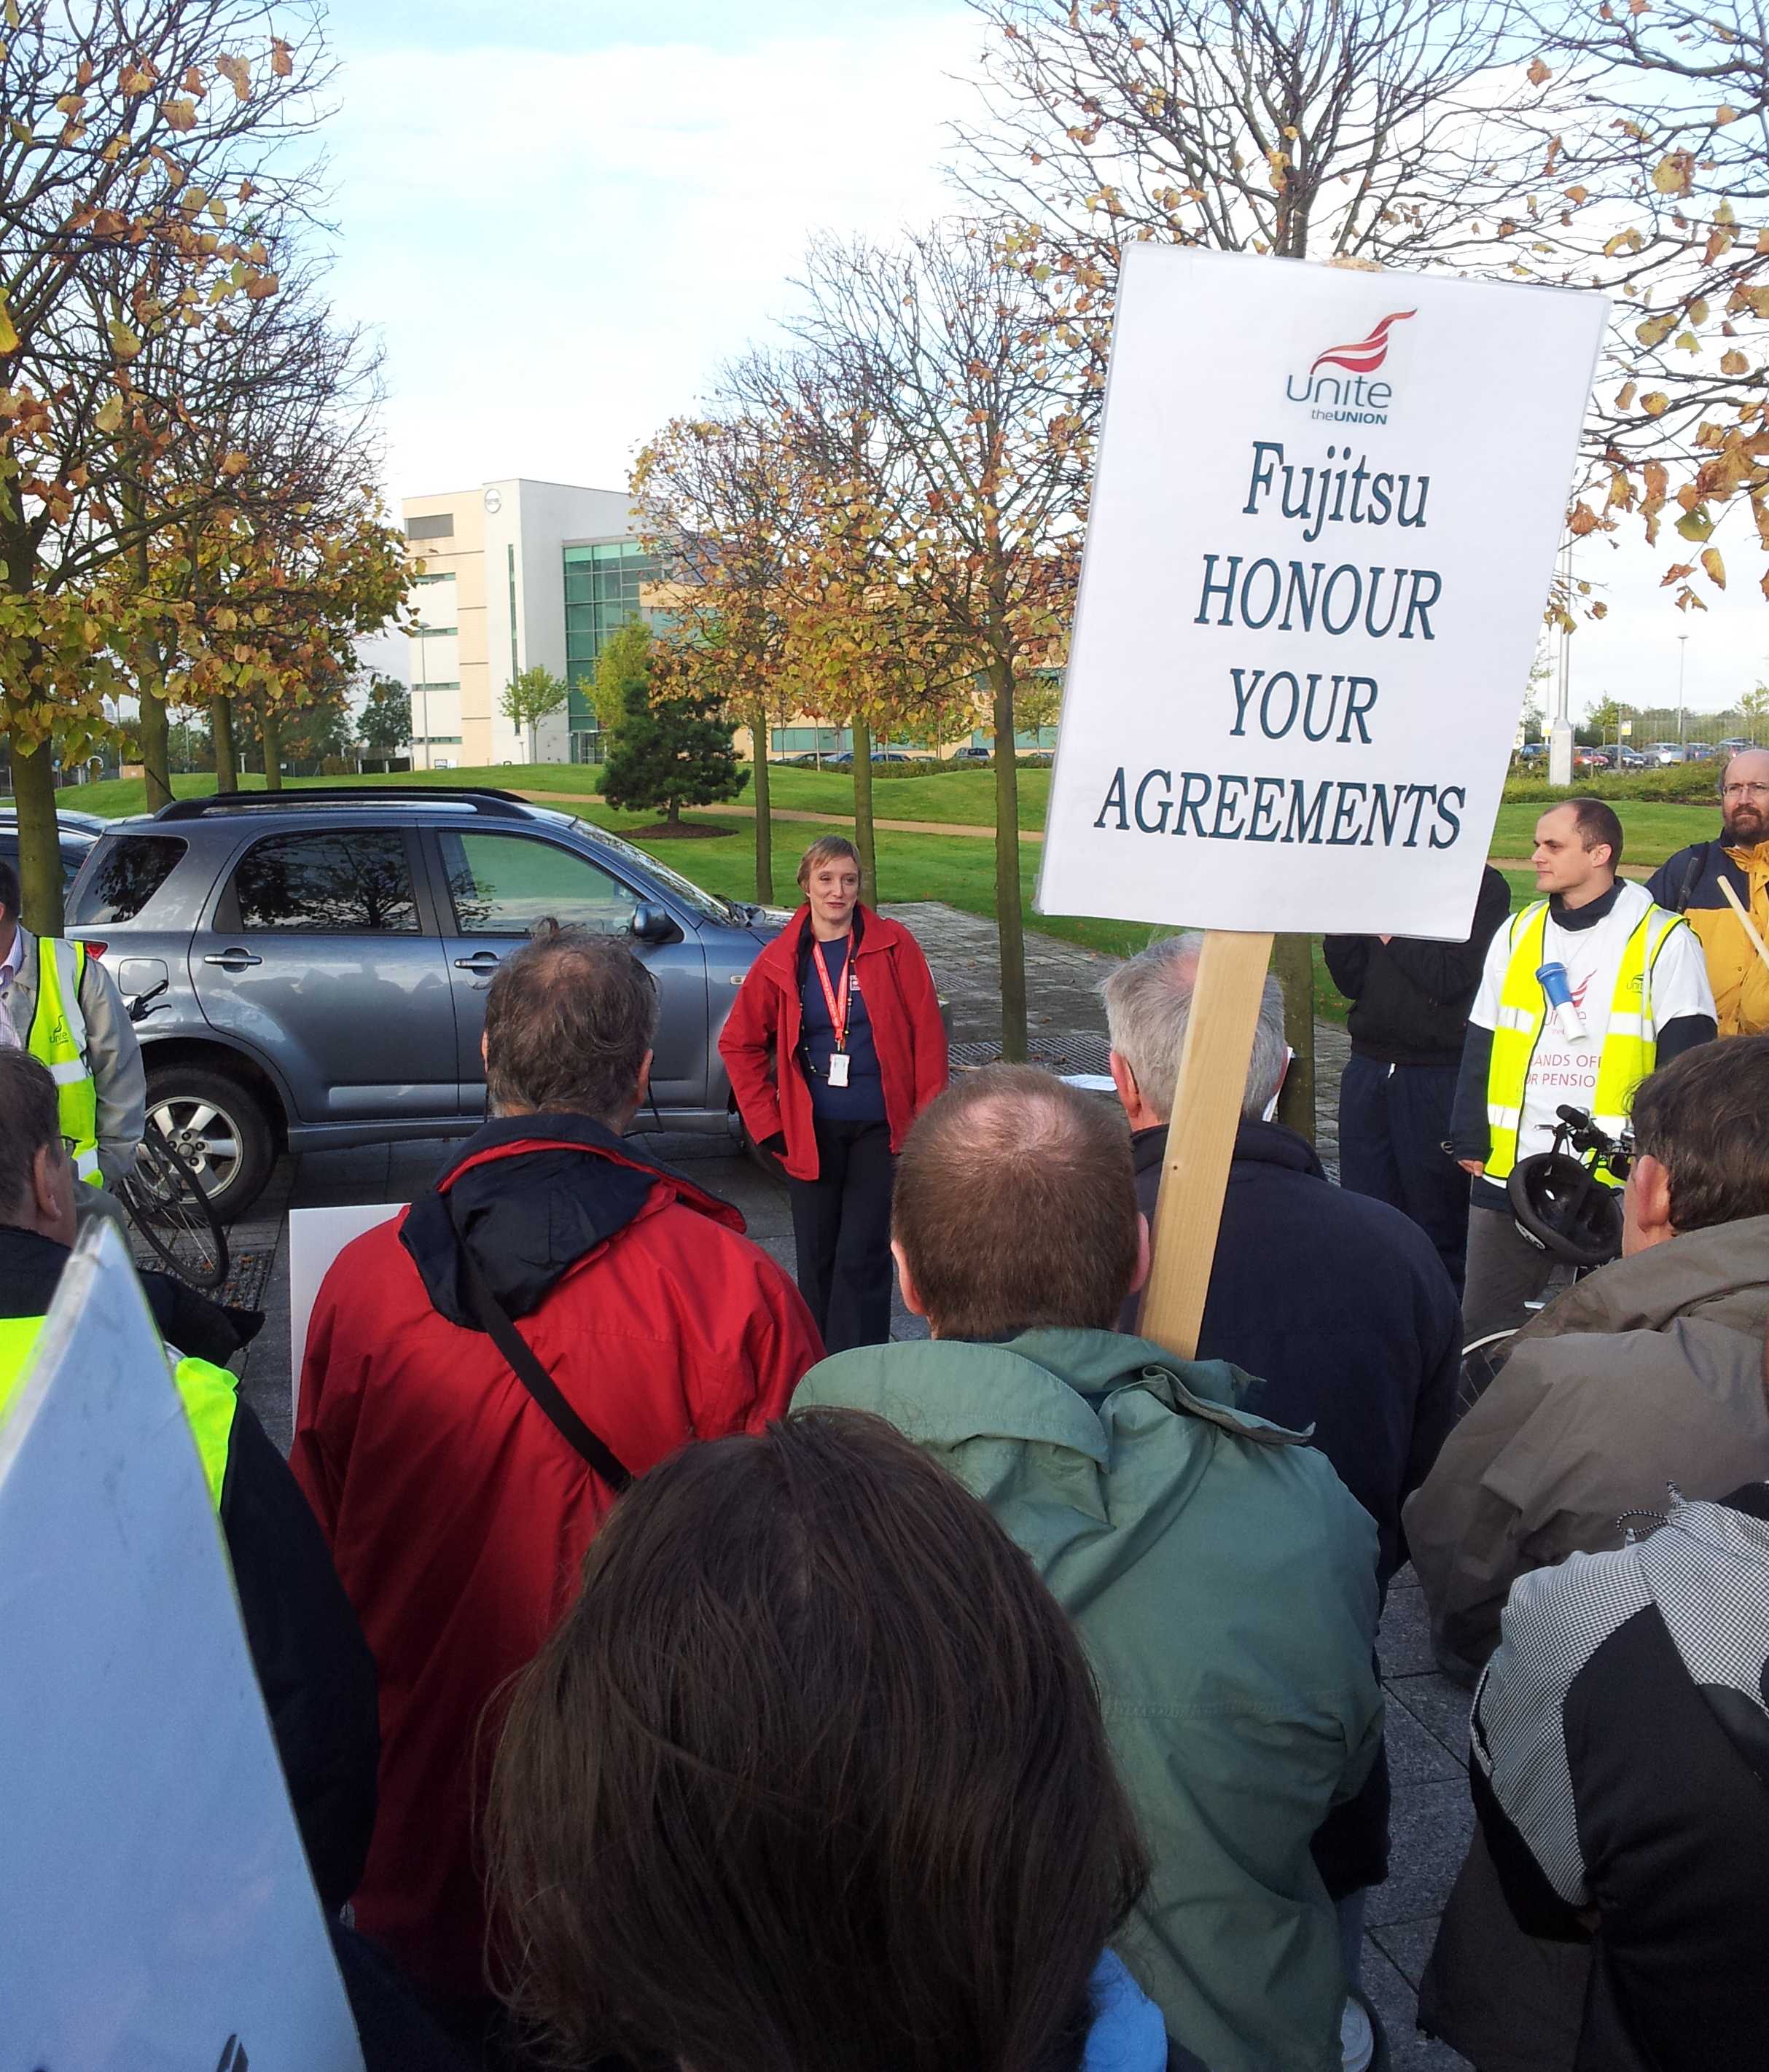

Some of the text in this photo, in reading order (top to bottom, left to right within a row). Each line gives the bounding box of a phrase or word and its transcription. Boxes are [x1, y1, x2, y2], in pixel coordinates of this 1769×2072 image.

[1311, 408, 1388, 426] theUNION
[1242, 441, 1430, 543] Fujitsu
[1193, 554, 1442, 641] HONOUR
[1230, 668, 1378, 744] YOUR
[1093, 767, 1466, 850] AGREEMENTS
[1626, 981, 1644, 990] unit
[1530, 1054, 1571, 1067] ANDS
[1542, 1074, 1596, 1088] PENSIO
